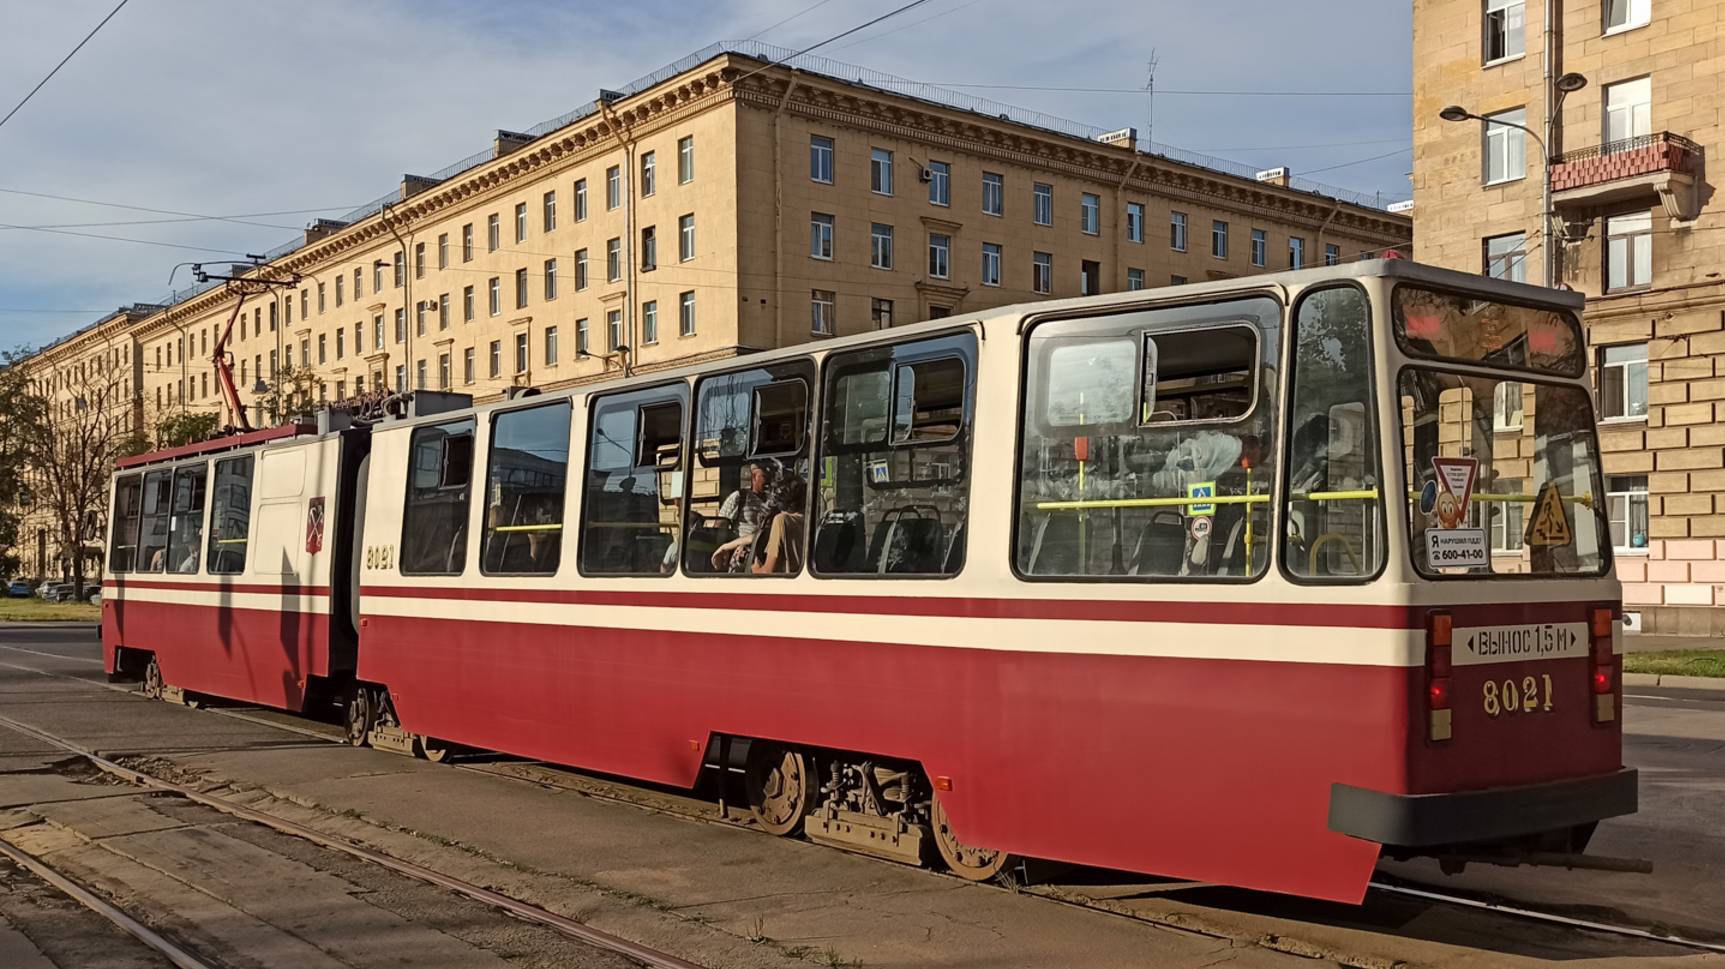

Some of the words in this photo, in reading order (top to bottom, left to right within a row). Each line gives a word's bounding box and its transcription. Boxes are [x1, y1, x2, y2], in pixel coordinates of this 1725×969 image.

[1431, 535, 1440, 548] Я
[1442, 549, 1484, 560] 600-41-00
[367, 544, 394, 570] 8021
[1479, 628, 1531, 656] ВЫНОС
[1534, 625, 1553, 657] 1,5
[1556, 628, 1567, 652] М
[1483, 673, 1554, 717] 8021
